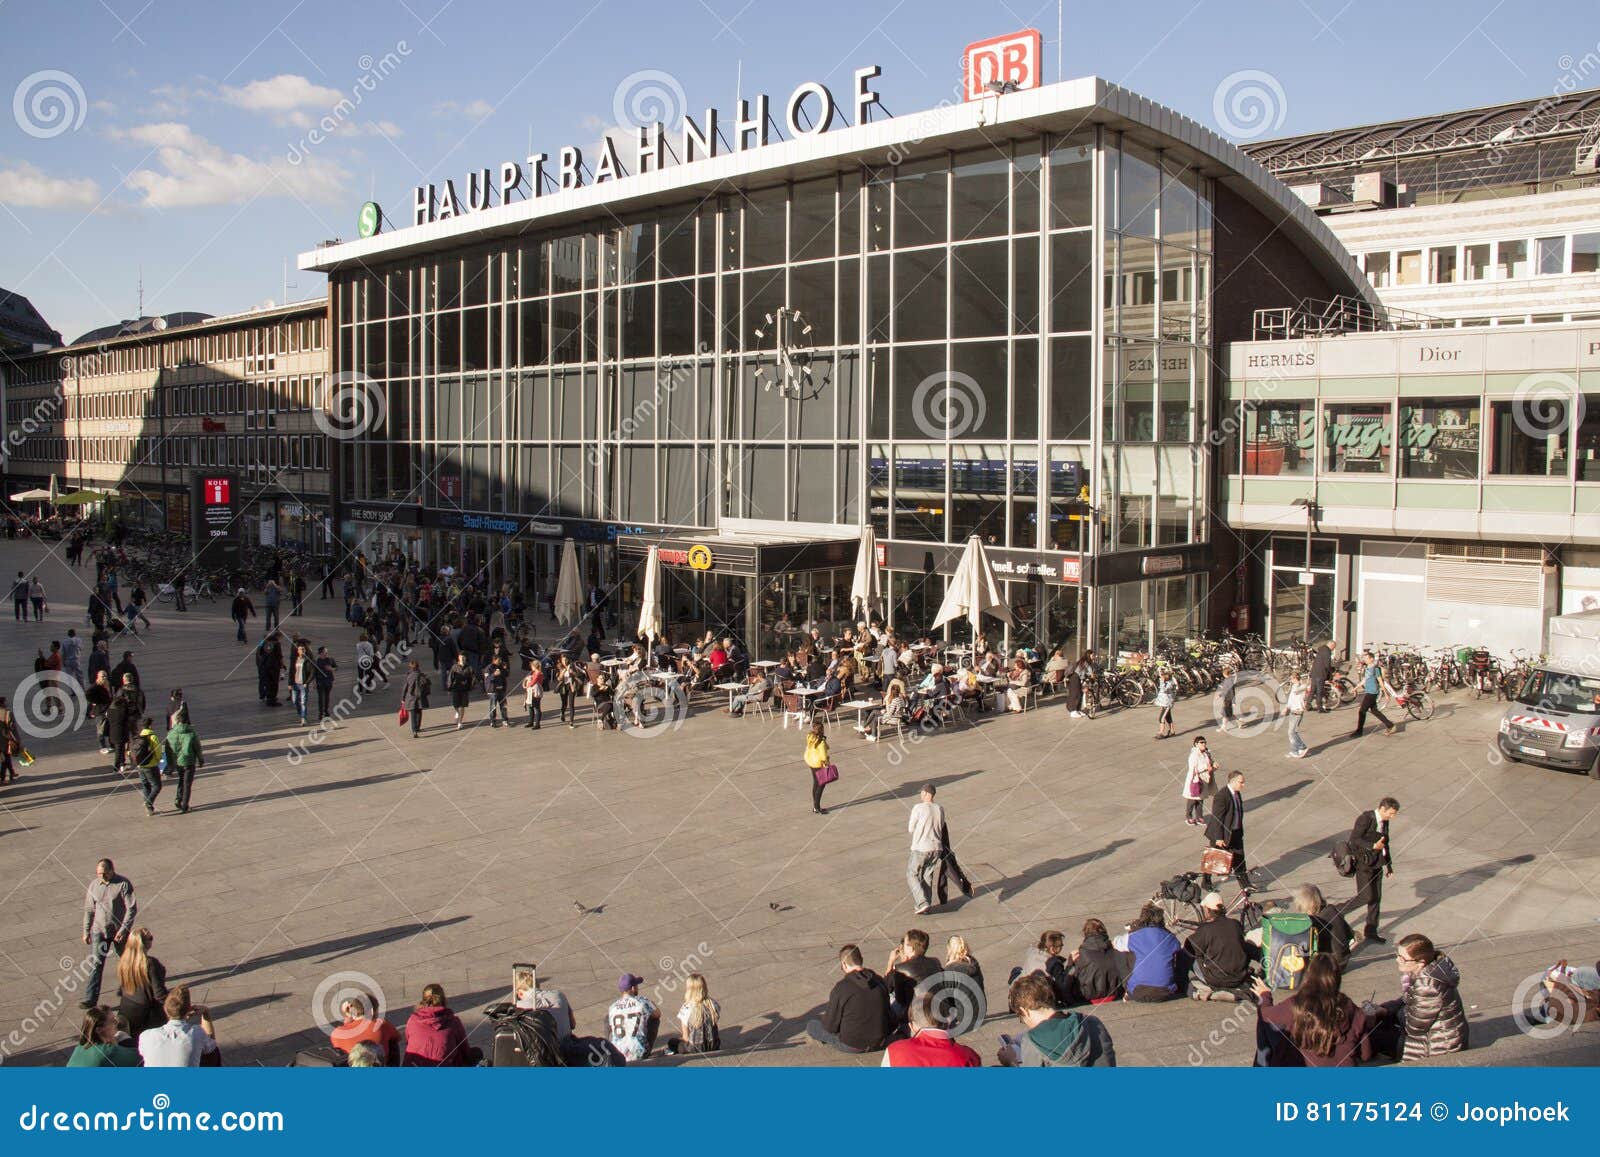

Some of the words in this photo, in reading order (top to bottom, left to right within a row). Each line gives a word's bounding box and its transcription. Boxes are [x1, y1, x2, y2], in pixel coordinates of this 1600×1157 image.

[973, 42, 1029, 96] DB
[413, 64, 882, 227] HAUPTBAHNHOF
[361, 206, 374, 236] S
[1420, 346, 1462, 362] Dior
[463, 514, 519, 535] Stadt-Anzeiger
[613, 1012, 642, 1038] 87
